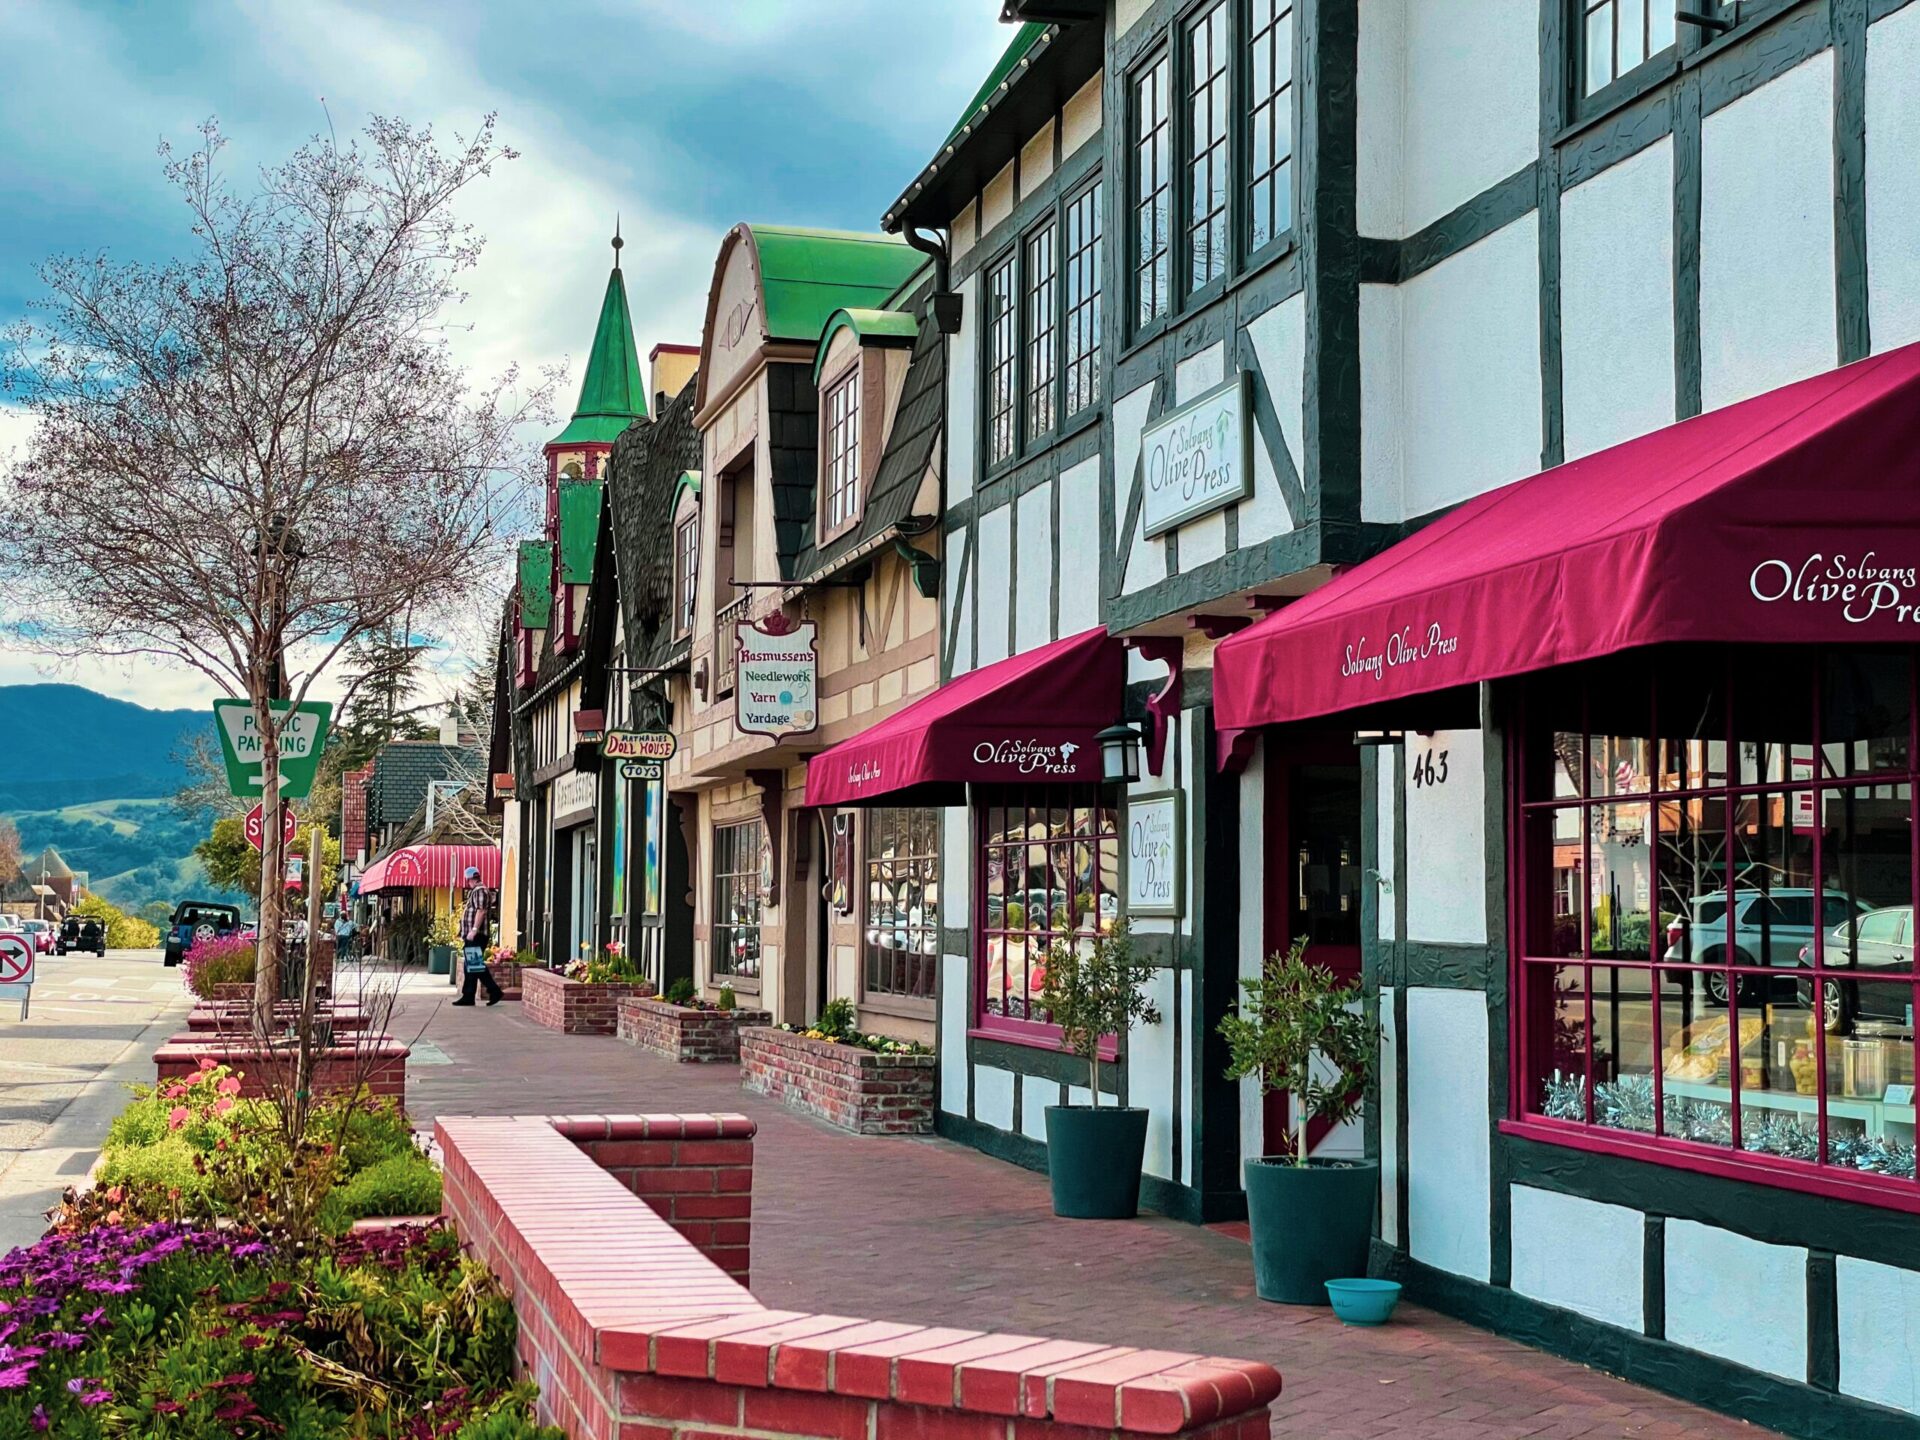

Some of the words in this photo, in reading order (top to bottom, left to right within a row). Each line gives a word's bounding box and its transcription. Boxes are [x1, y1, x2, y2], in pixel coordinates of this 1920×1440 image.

[1176, 414, 1214, 455] Solvang
[1150, 428, 1189, 492] Olive
[1182, 448, 1231, 501] Press
[1749, 553, 1857, 602] Olive
[1826, 551, 1916, 588] Solvang
[740, 649, 814, 663] Rasmussen's
[1342, 636, 1383, 680] Solvang
[1387, 625, 1418, 666] Olive
[1420, 621, 1458, 659] Press
[745, 670, 811, 682] Needlework
[750, 692, 776, 703] Yarn
[746, 712, 790, 725] Yardage
[607, 736, 637, 755] DOLL
[640, 742, 672, 755] HOUSE
[973, 739, 1027, 763] Olive
[1018, 752, 1077, 774] Press
[1011, 738, 1056, 757] Solvang
[625, 766, 659, 778] TOYS
[1412, 748, 1449, 789] 463
[248, 817, 294, 837] SP
[1131, 813, 1159, 859] Olive
[1139, 858, 1171, 898] Press
